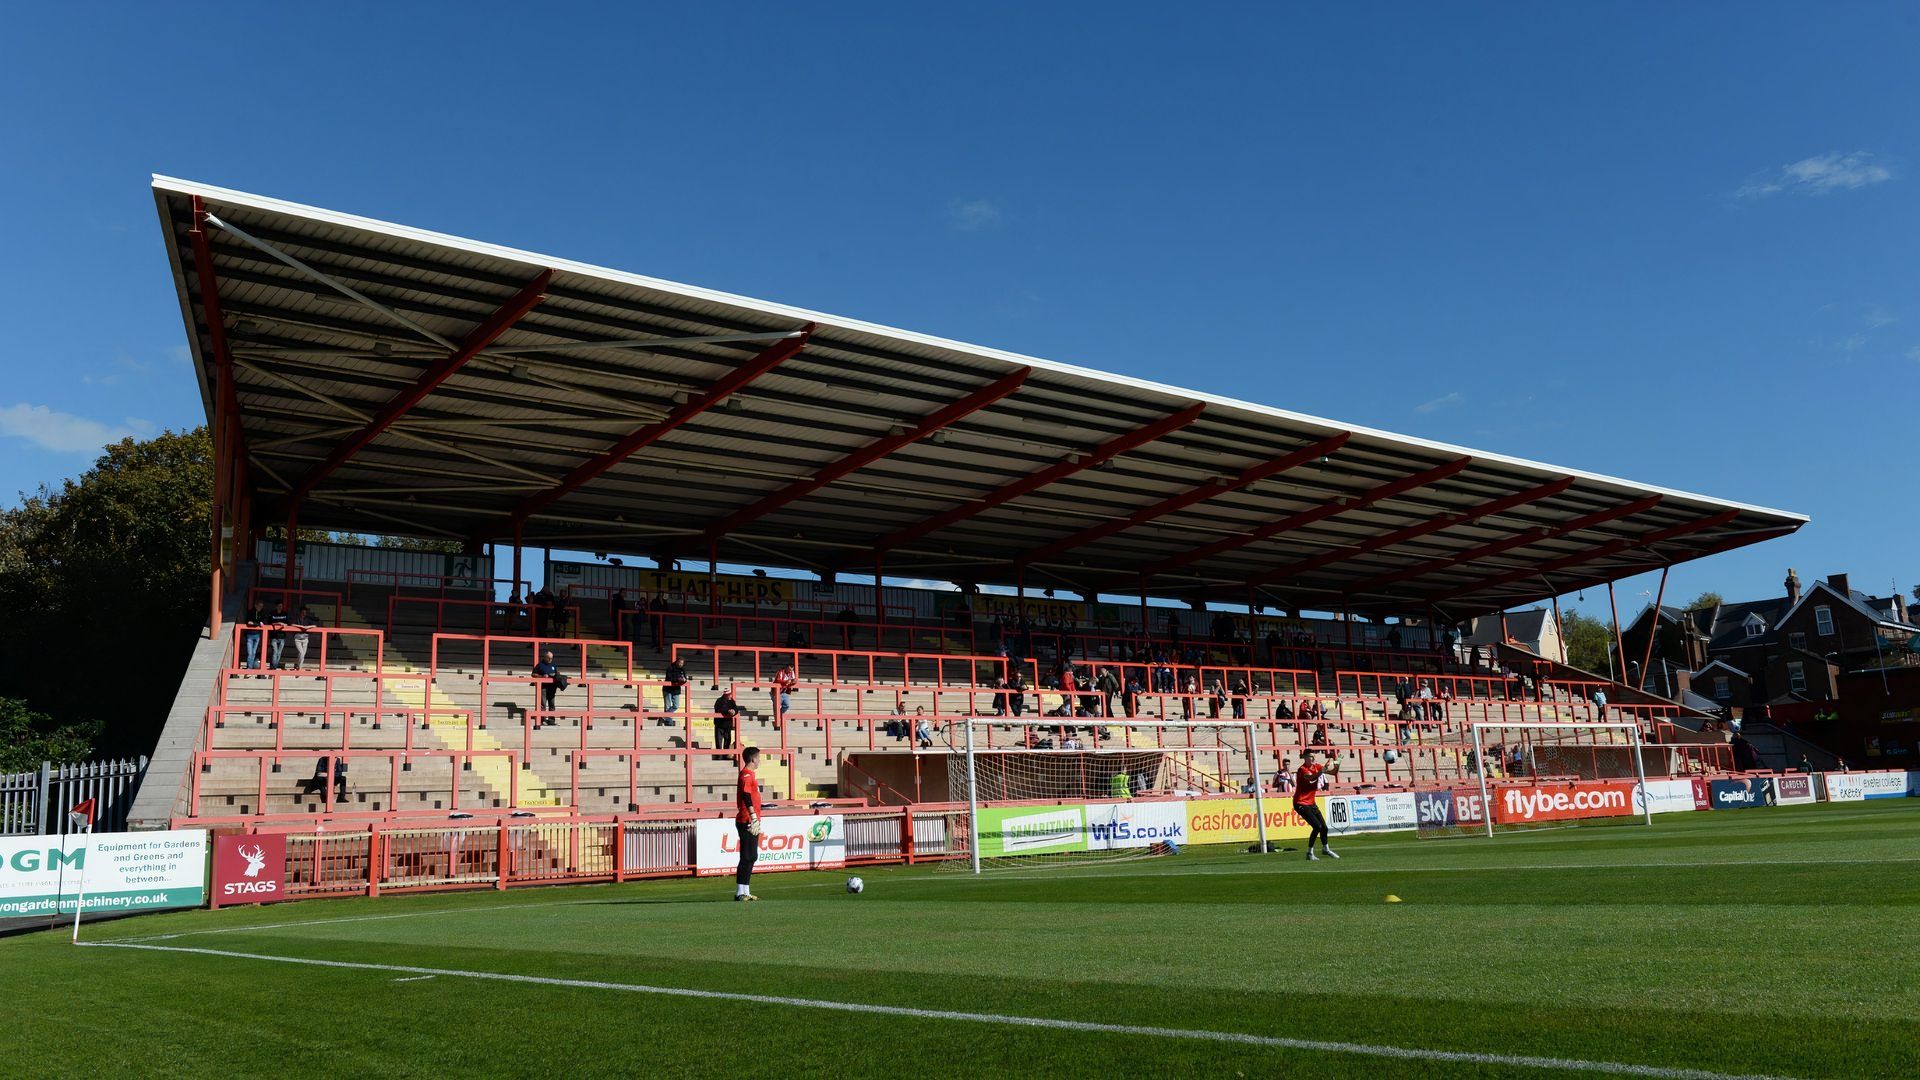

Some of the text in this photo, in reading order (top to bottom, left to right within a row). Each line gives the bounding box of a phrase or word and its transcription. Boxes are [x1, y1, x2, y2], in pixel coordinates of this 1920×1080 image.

[1331, 802, 1347, 823] RGB
[1503, 789, 1626, 818] flybe.com
[1010, 818, 1075, 838] SAMARITANS
[1092, 818, 1182, 841] wts.co.uk
[1191, 808, 1309, 831] cashcoverte
[97, 840, 200, 852] Equipment for Gardens
[721, 832, 804, 853] Lton
[0, 847, 86, 872] GM
[113, 851, 184, 862] and Greens and
[758, 851, 803, 862] BRICANTS
[119, 864, 166, 873] everything
[224, 880, 277, 895] STAGS
[0, 892, 168, 913] ongardenmachinery.co.uk
